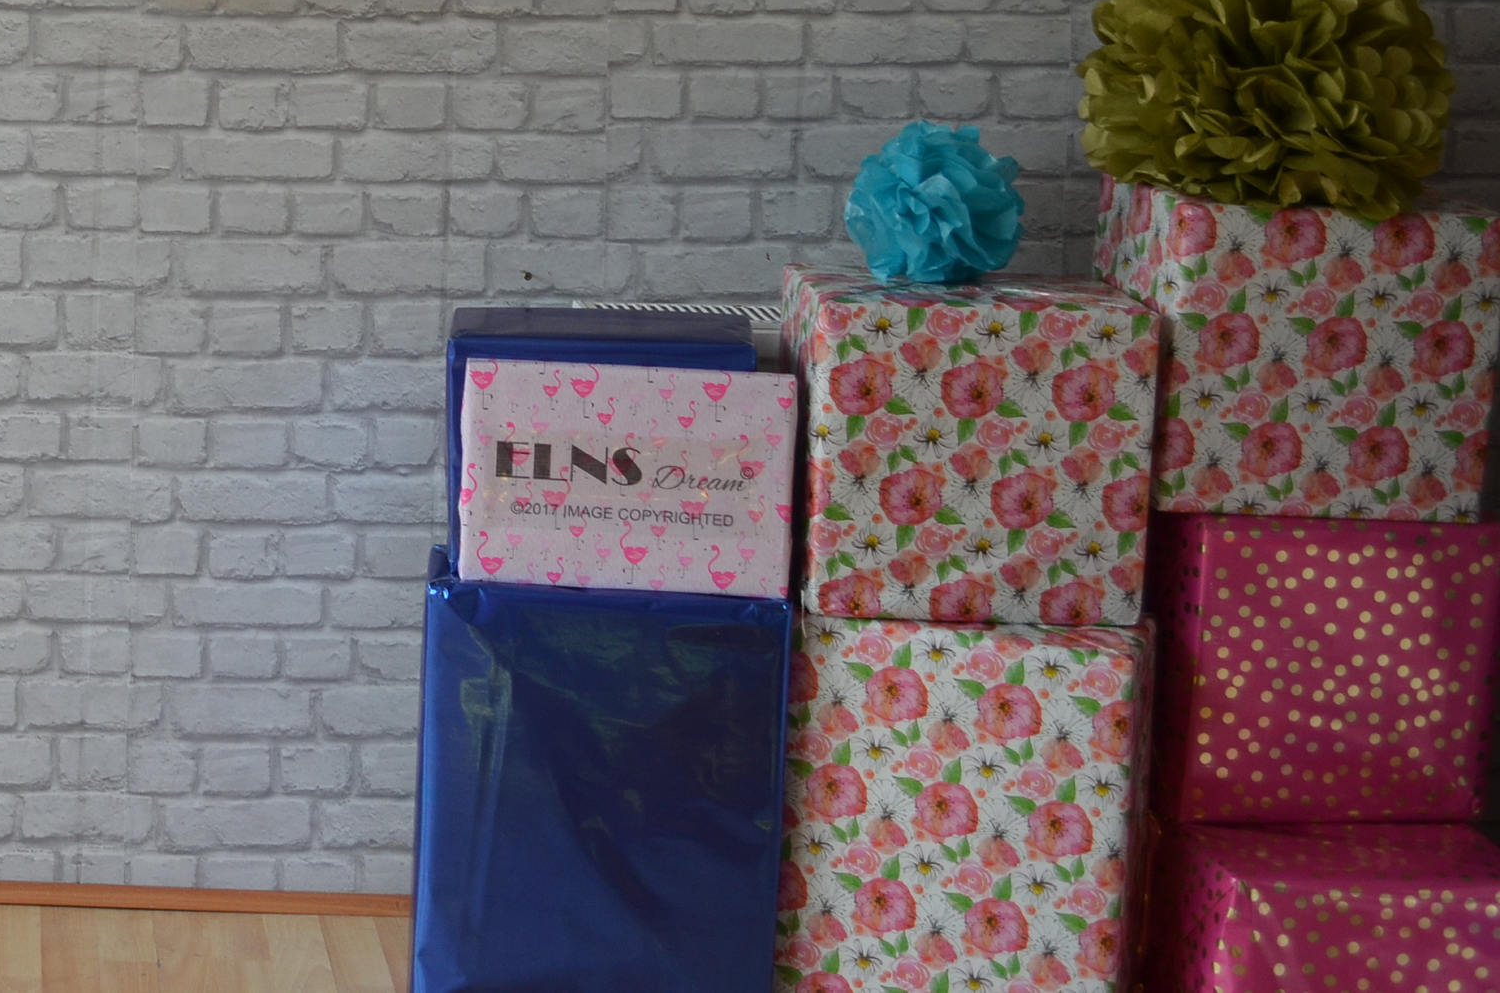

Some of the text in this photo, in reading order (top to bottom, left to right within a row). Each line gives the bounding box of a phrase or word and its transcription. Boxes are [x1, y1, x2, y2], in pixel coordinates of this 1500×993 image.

[495, 440, 643, 486] ELNS
[563, 505, 612, 521] IMAGE
[617, 508, 734, 527] COPYRIGHTED
